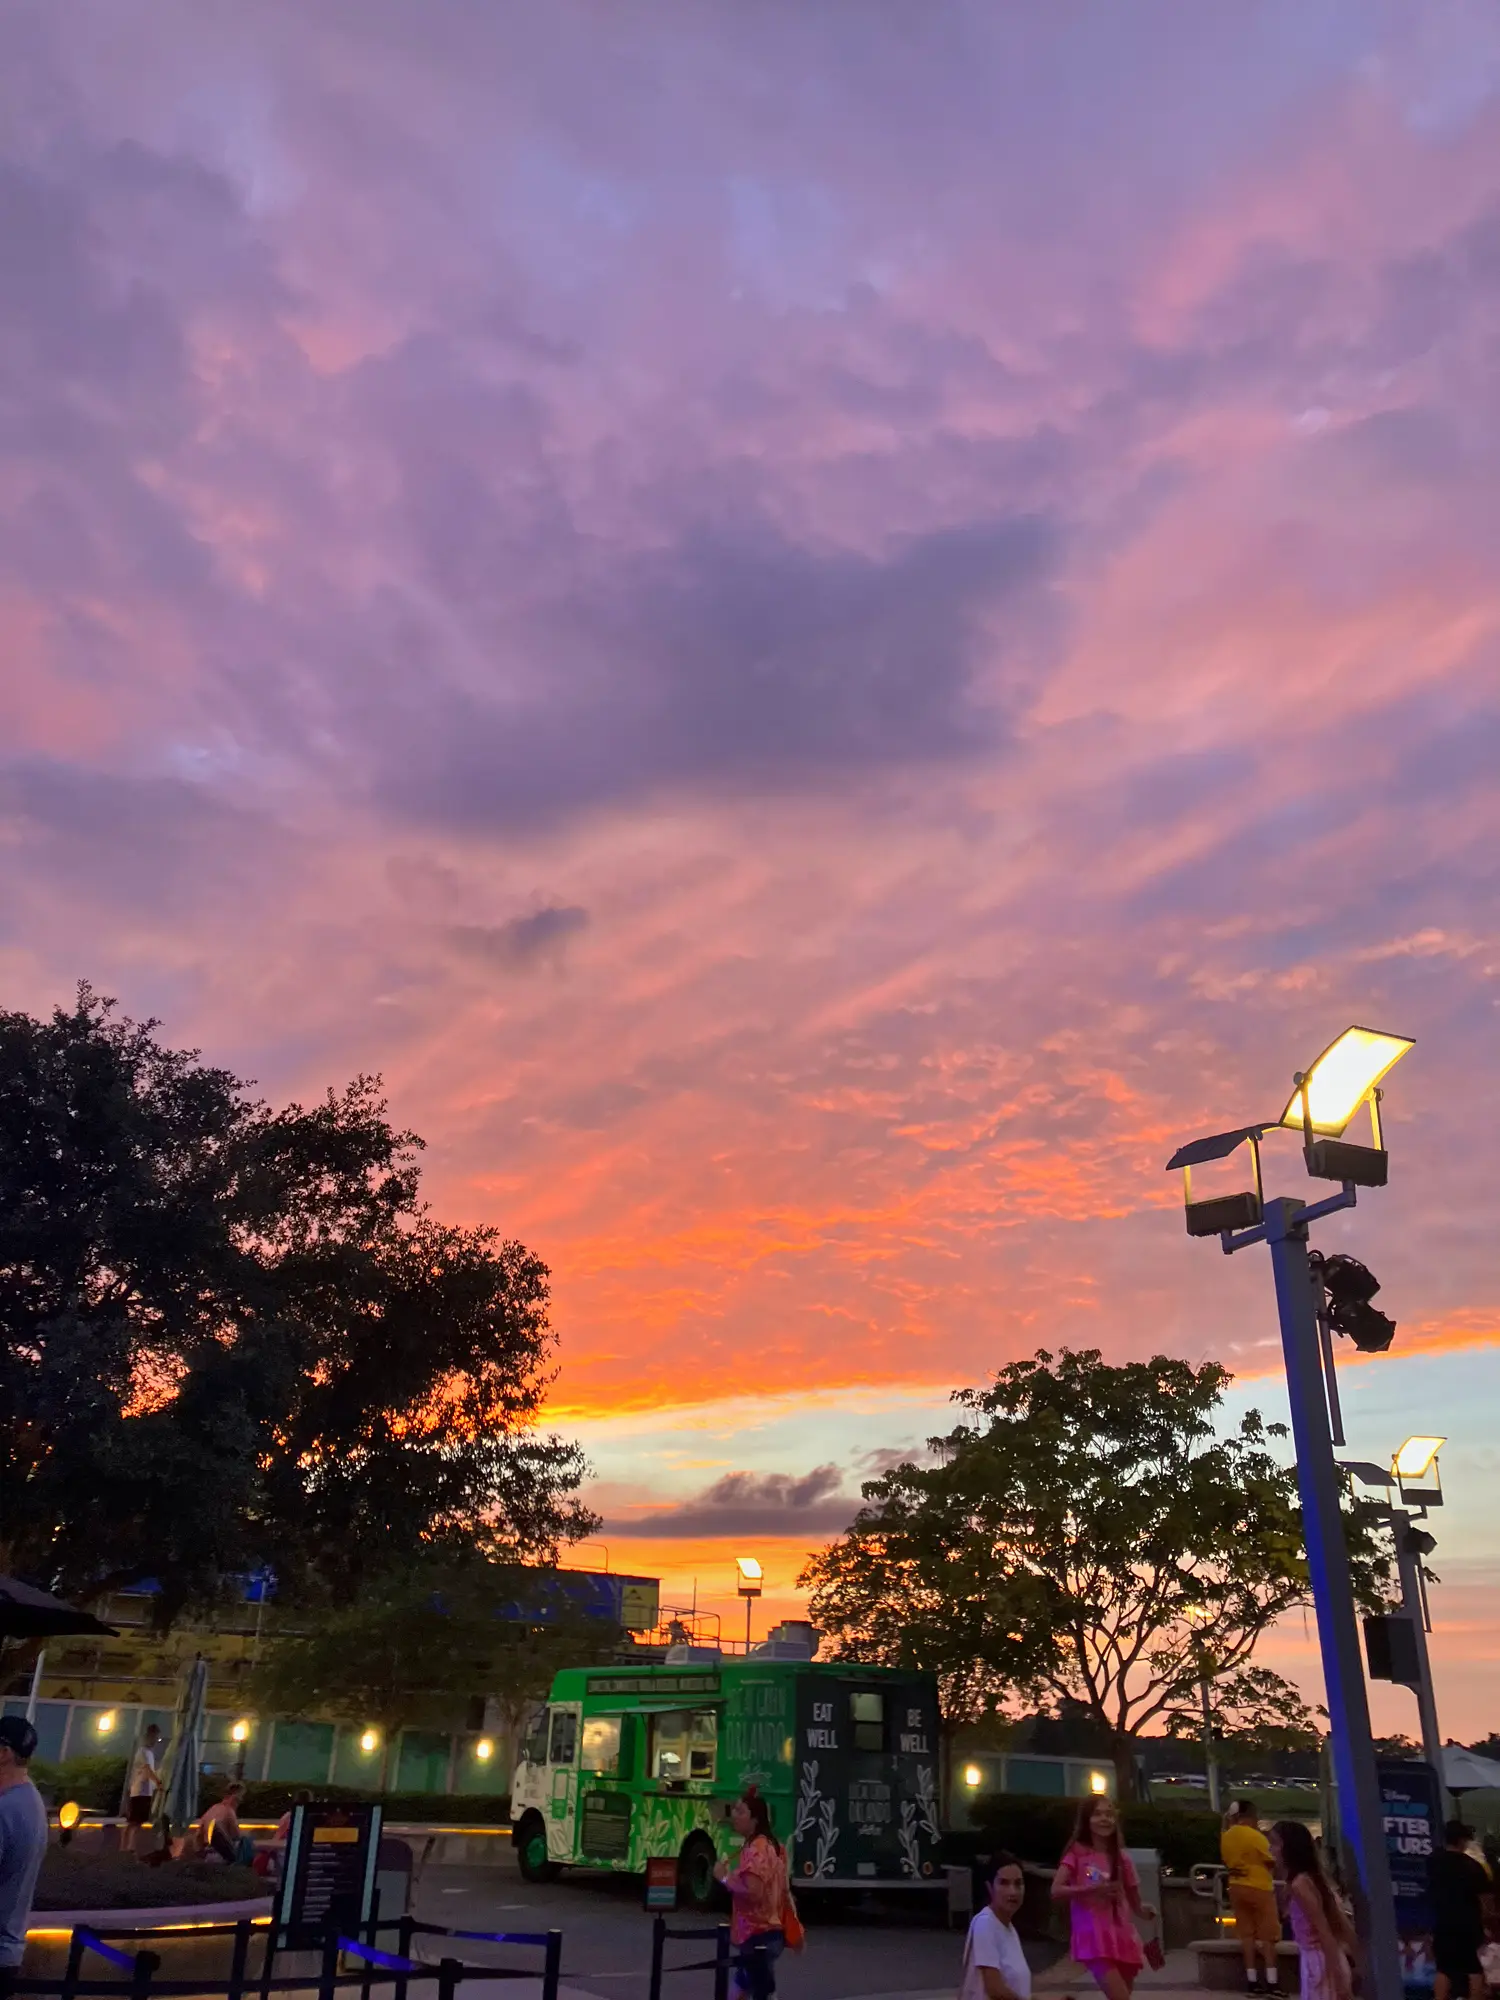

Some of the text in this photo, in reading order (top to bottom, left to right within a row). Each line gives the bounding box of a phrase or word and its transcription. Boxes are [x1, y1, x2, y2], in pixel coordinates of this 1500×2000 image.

[812, 1702, 834, 1722] EAT
[906, 1708, 923, 1728] BE
[726, 1721, 786, 1762] ORLANDO
[806, 1728, 839, 1749] WELL
[900, 1733, 931, 1754] WELL
[1382, 1816, 1431, 1836] FTER
[1388, 1837, 1434, 1856] URS
